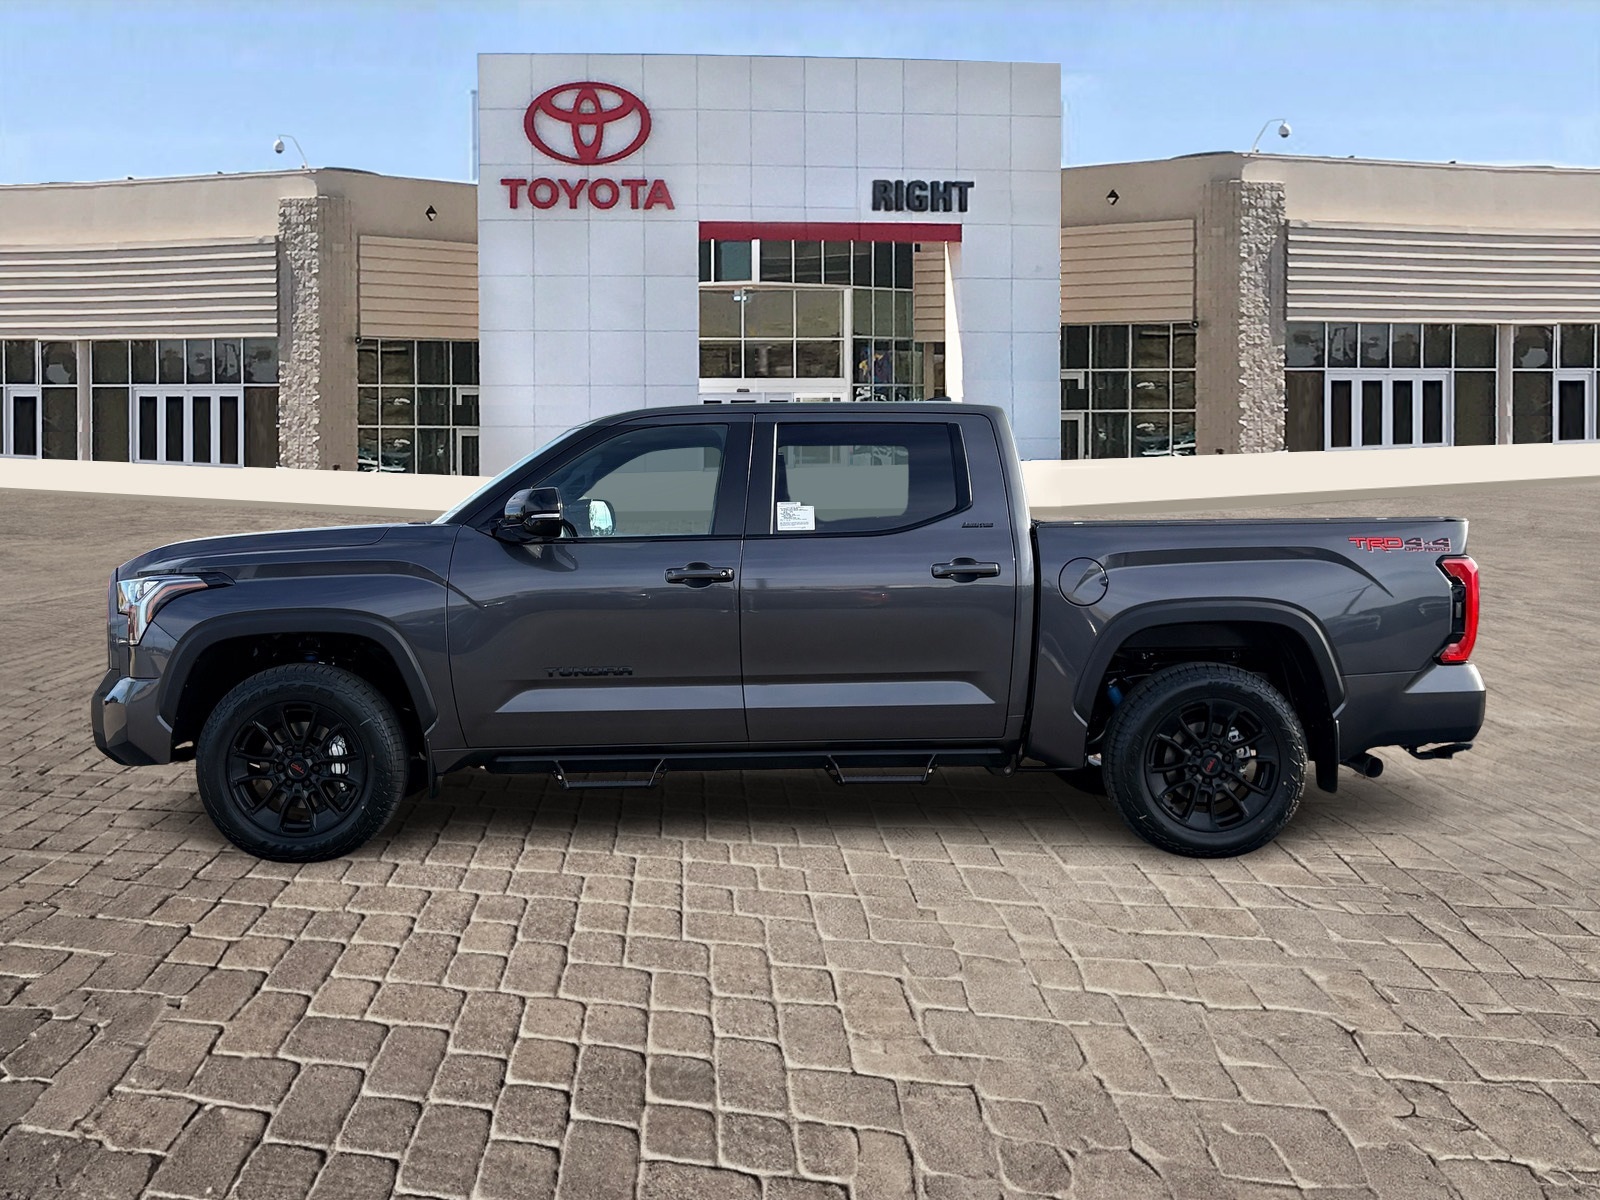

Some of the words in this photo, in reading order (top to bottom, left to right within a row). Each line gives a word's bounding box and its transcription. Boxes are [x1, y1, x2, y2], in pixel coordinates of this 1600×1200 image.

[500, 178, 675, 210] TOYOTA
[871, 179, 975, 212] RIGHT
[1348, 537, 1404, 551] TRD
[544, 666, 632, 677] TUNDRA
